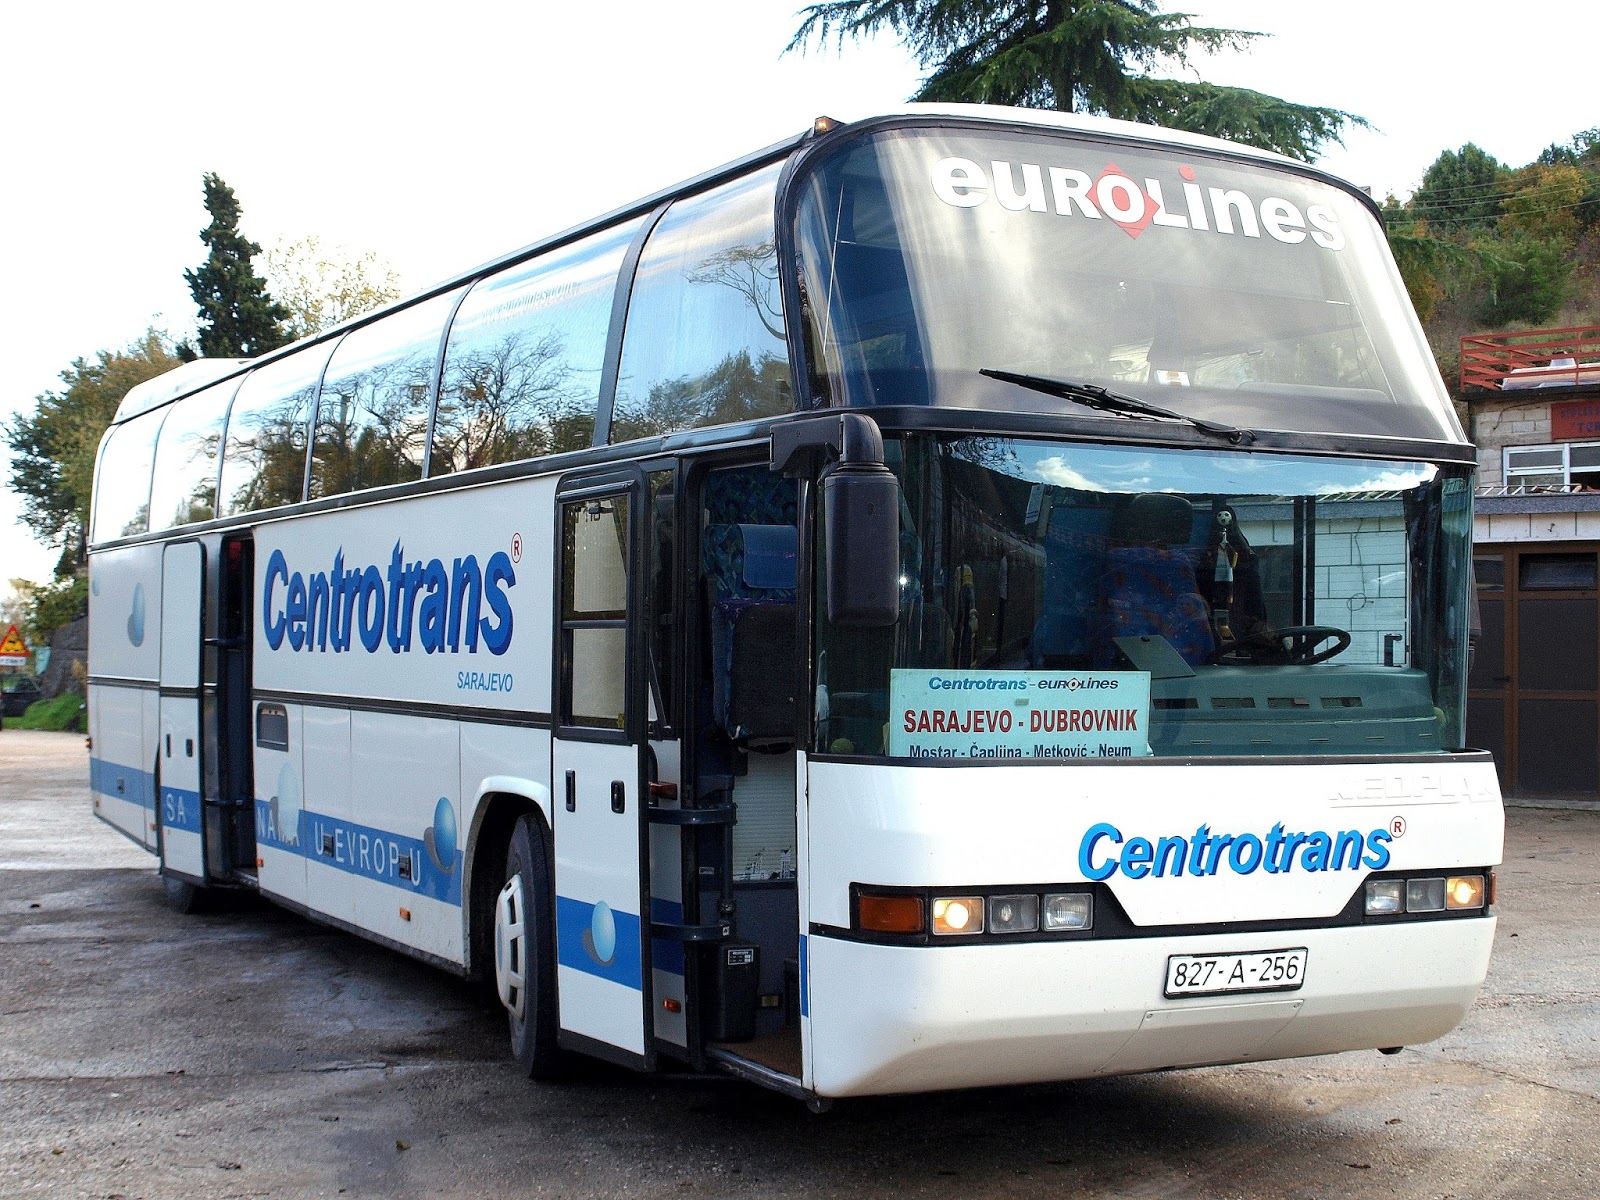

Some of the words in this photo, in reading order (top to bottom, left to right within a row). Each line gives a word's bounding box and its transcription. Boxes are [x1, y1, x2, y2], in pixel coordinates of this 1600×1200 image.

[263, 536, 516, 656] Centrotrans
[456, 671, 514, 693] SARAJEVO
[928, 676, 1028, 691] Centrotrans
[903, 709, 1013, 733] SARAJEVO
[1030, 709, 1138, 732] DUBROVNIK
[909, 744, 957, 757] Mostar
[1033, 743, 1088, 757] Metković
[1098, 743, 1132, 757] Neum
[314, 821, 325, 856] U
[1078, 822, 1393, 881] Centrotrans
